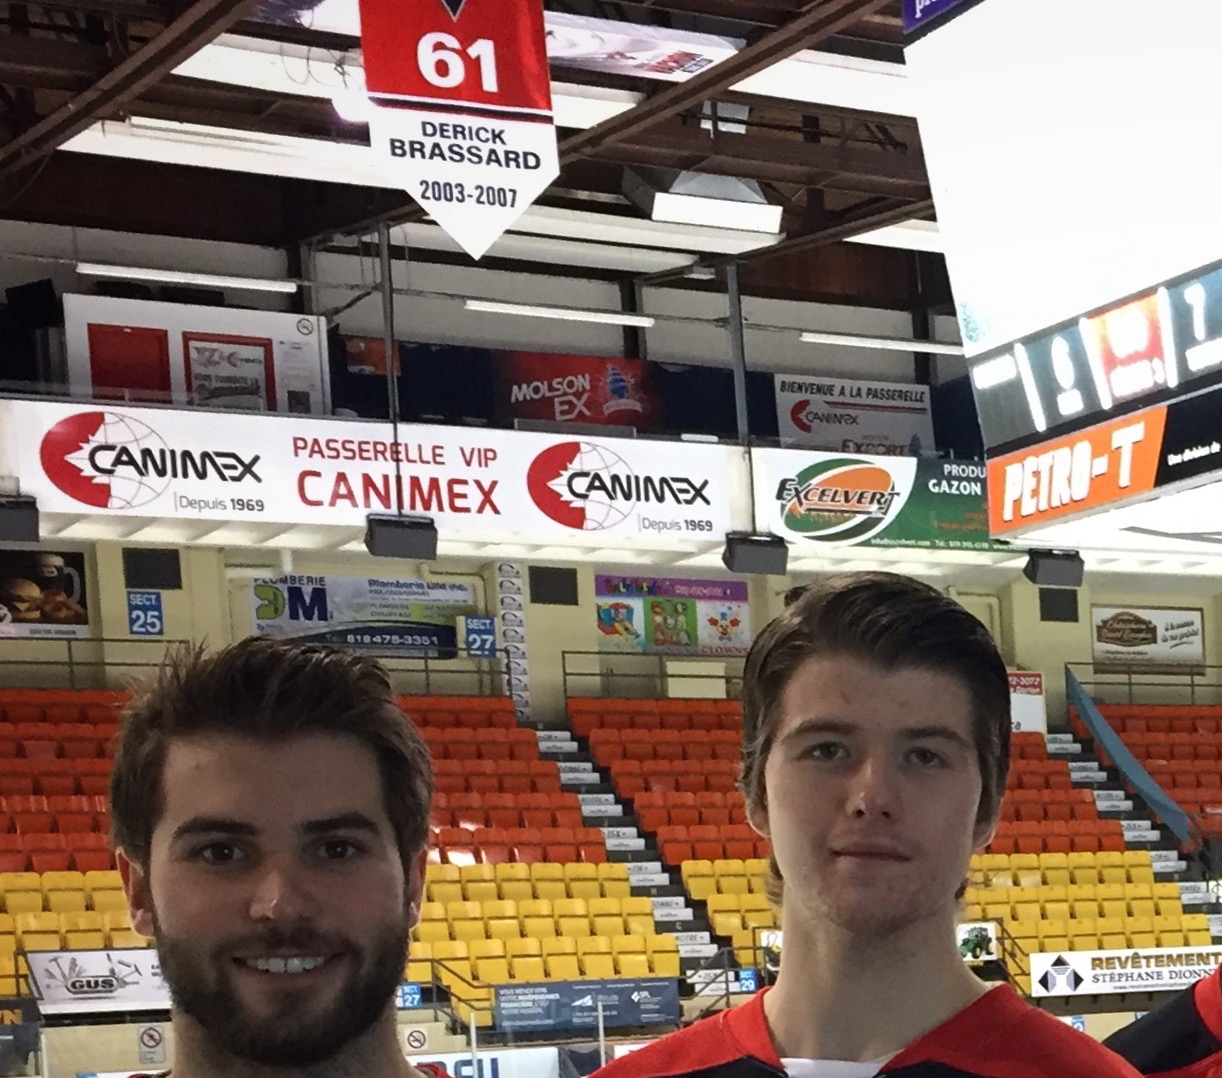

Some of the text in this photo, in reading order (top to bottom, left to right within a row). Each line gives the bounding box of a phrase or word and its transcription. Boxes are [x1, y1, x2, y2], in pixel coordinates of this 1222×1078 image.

[416, 31, 499, 93] 61
[421, 121, 507, 146] DERICK
[389, 138, 542, 170] BRASSARD
[419, 179, 517, 208] 2003-2007
[511, 374, 591, 403] MOLSON
[780, 380, 926, 403] BIENVENUE A LA PASSERELLE
[554, 393, 591, 421] EX
[88, 444, 262, 483] CANIMEX
[292, 436, 498, 467] PASSERELLE VIP
[297, 470, 501, 515] CANIMEX
[566, 470, 711, 506] CANIMEX
[928, 478, 982, 496] GAZON
[178, 495, 265, 511] Depuis 1969
[642, 516, 713, 533] Depuis 1969
[131, 609, 161, 634] 25
[468, 632, 494, 655] 27
[70, 978, 115, 990] GUS
[1092, 970, 1164, 984] STÉPHANE
[404, 995, 420, 1007] 27
